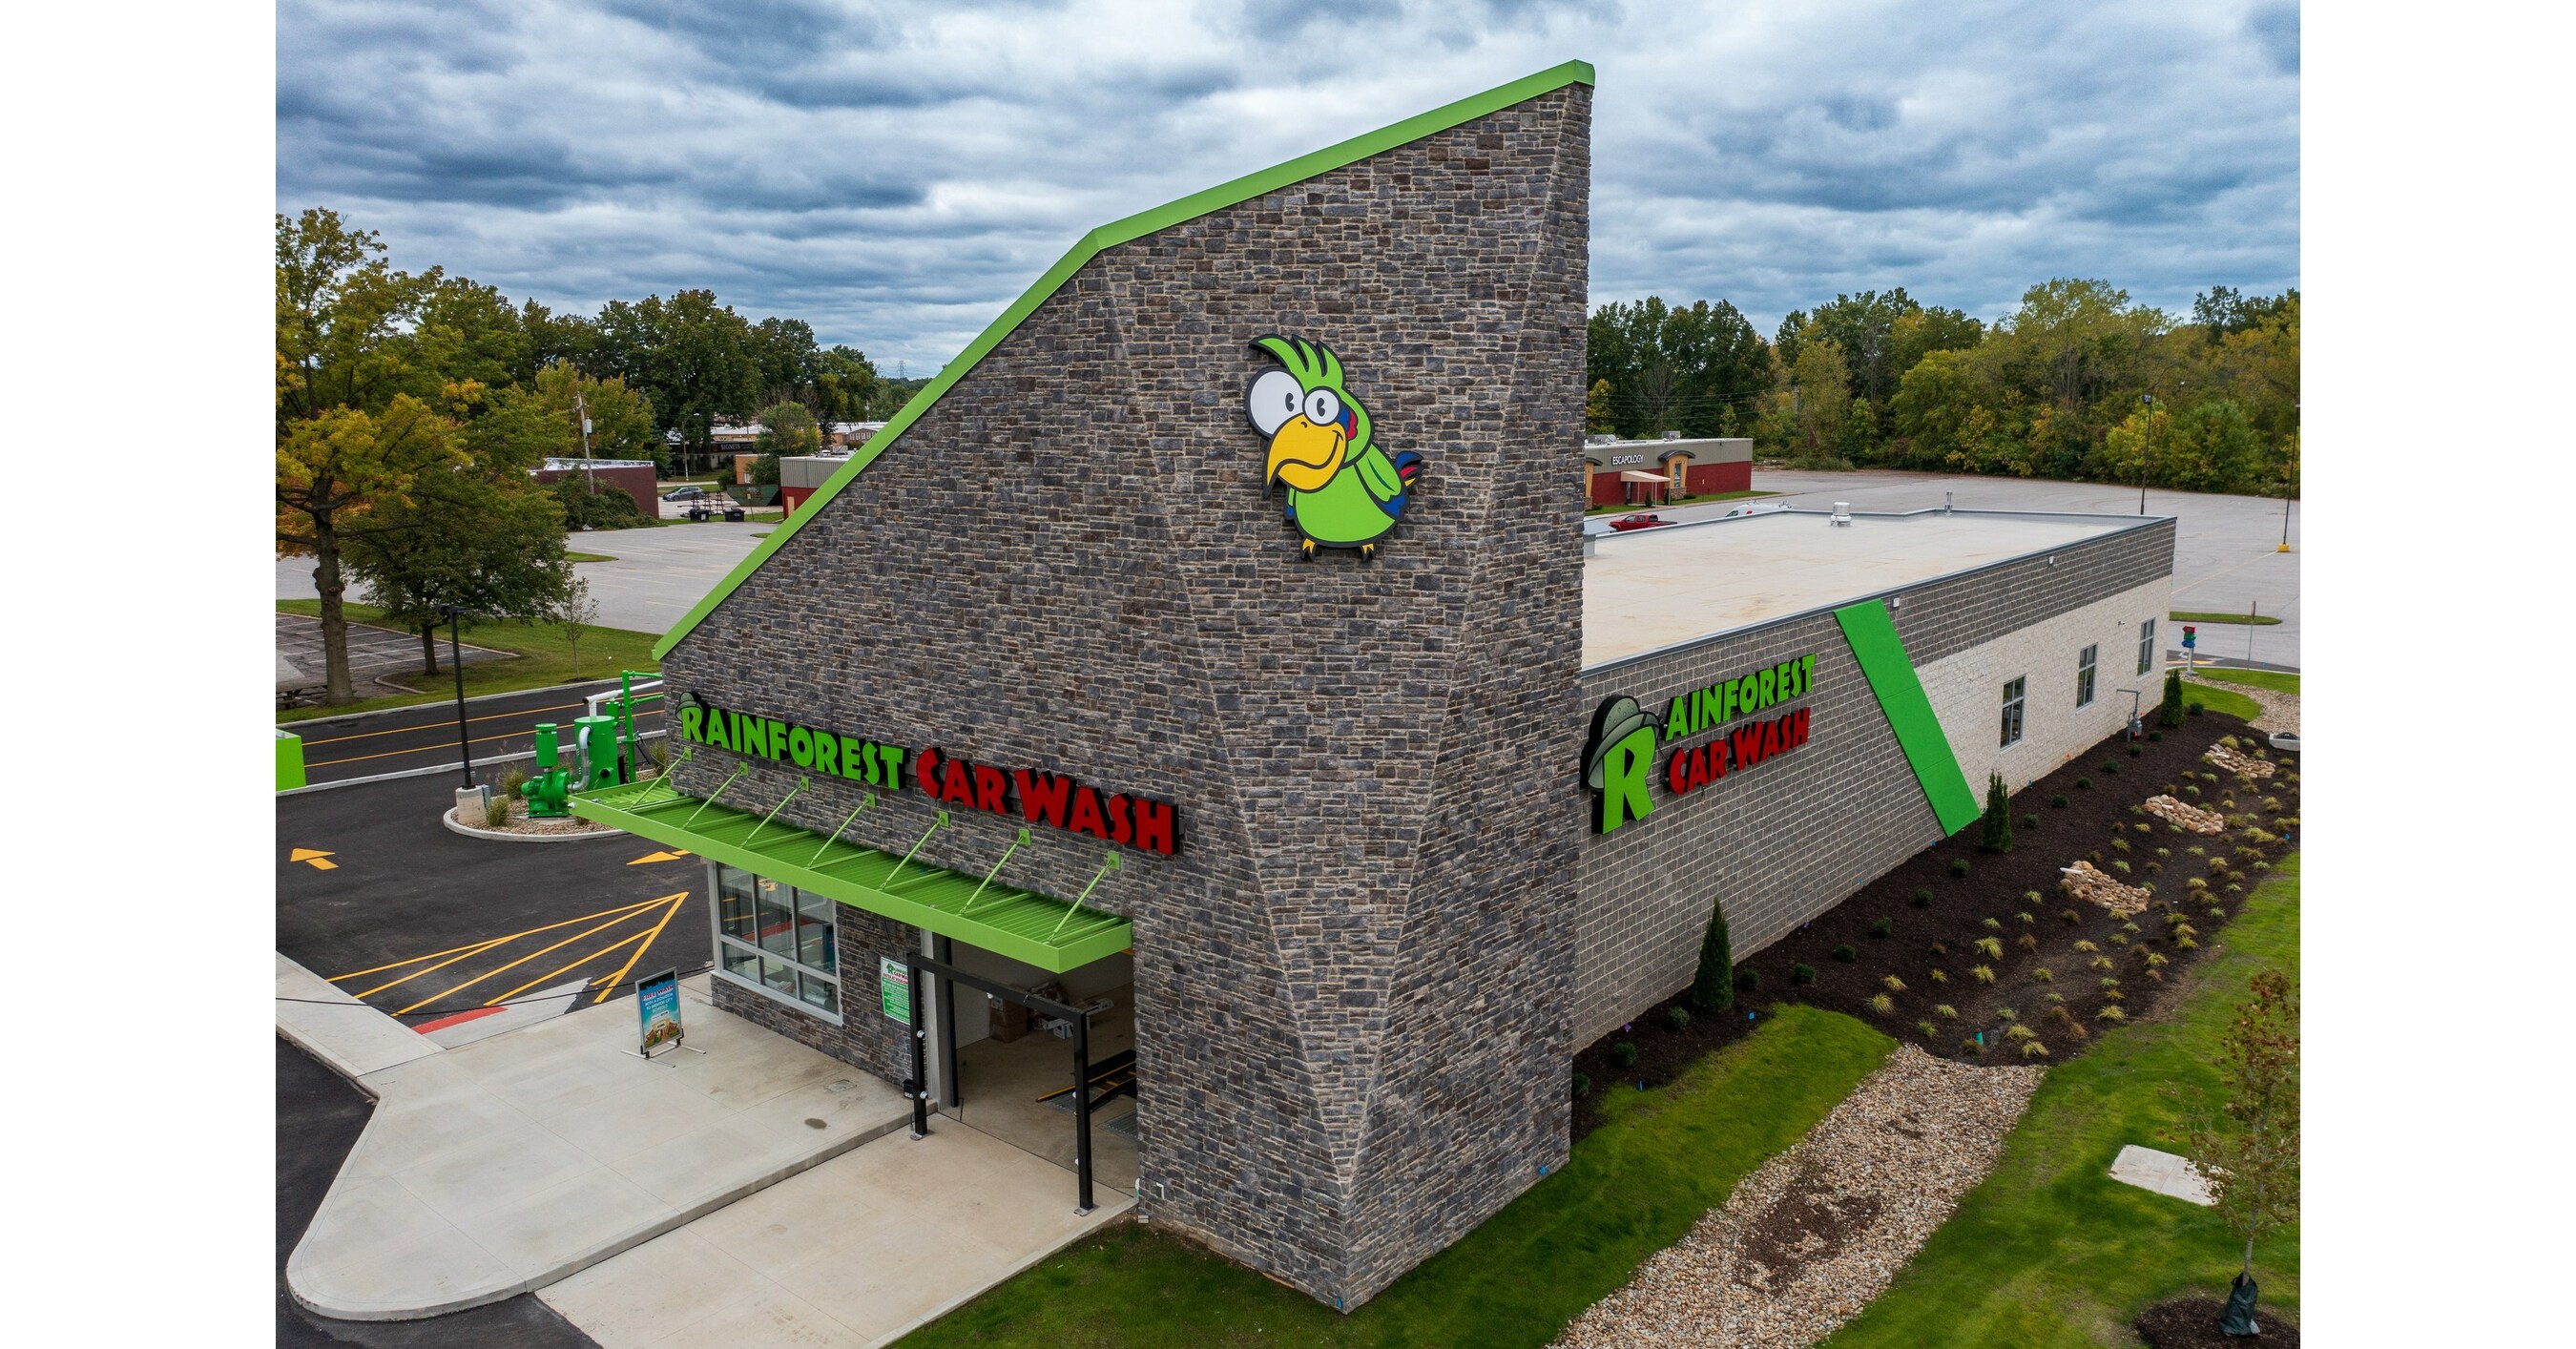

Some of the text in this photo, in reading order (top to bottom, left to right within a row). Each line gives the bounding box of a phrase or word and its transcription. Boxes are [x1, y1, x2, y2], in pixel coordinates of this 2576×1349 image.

[1613, 454, 1644, 465] ESCAPOLOGY
[1668, 707, 1811, 795] CAR WASH
[681, 706, 1174, 856] RAINFOREST CAR WASH
[642, 985, 674, 1001] FREE WASH
